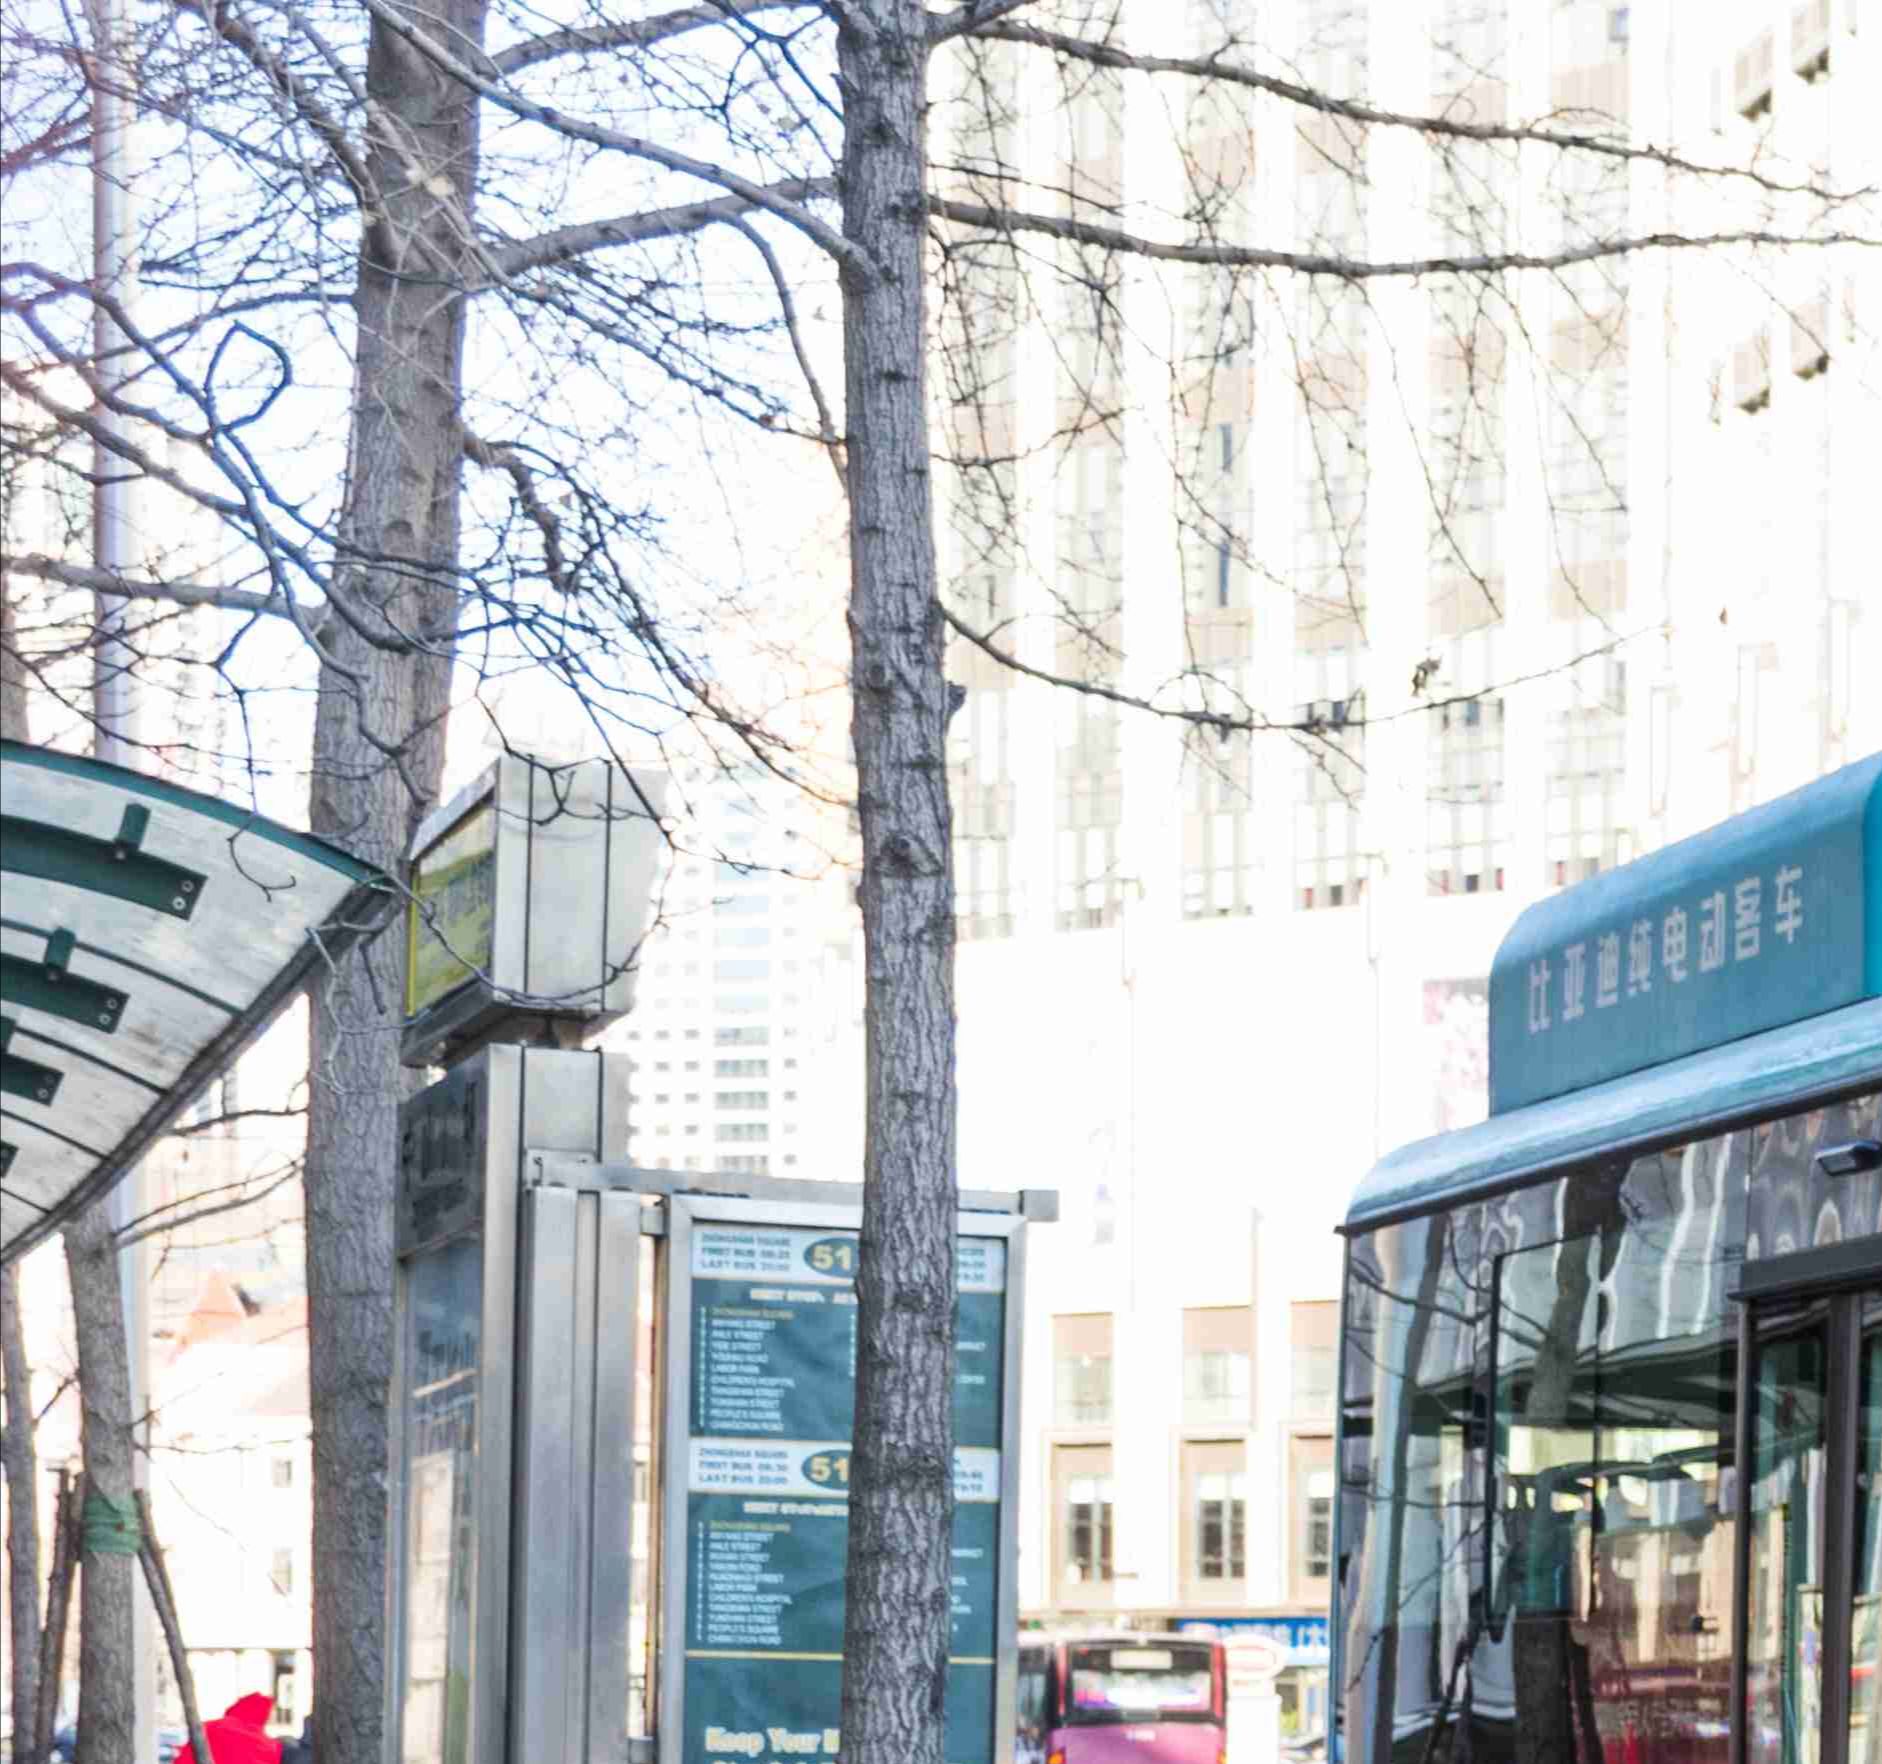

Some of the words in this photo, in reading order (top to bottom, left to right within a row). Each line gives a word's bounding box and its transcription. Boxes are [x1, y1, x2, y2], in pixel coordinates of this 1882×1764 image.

[1527, 863, 1805, 1034] 比亚迪纯电动客车
[812, 1243, 852, 1271] 51
[810, 1456, 849, 1482] 51
[705, 1726, 764, 1758] Keep
[767, 1728, 821, 1754] Your
